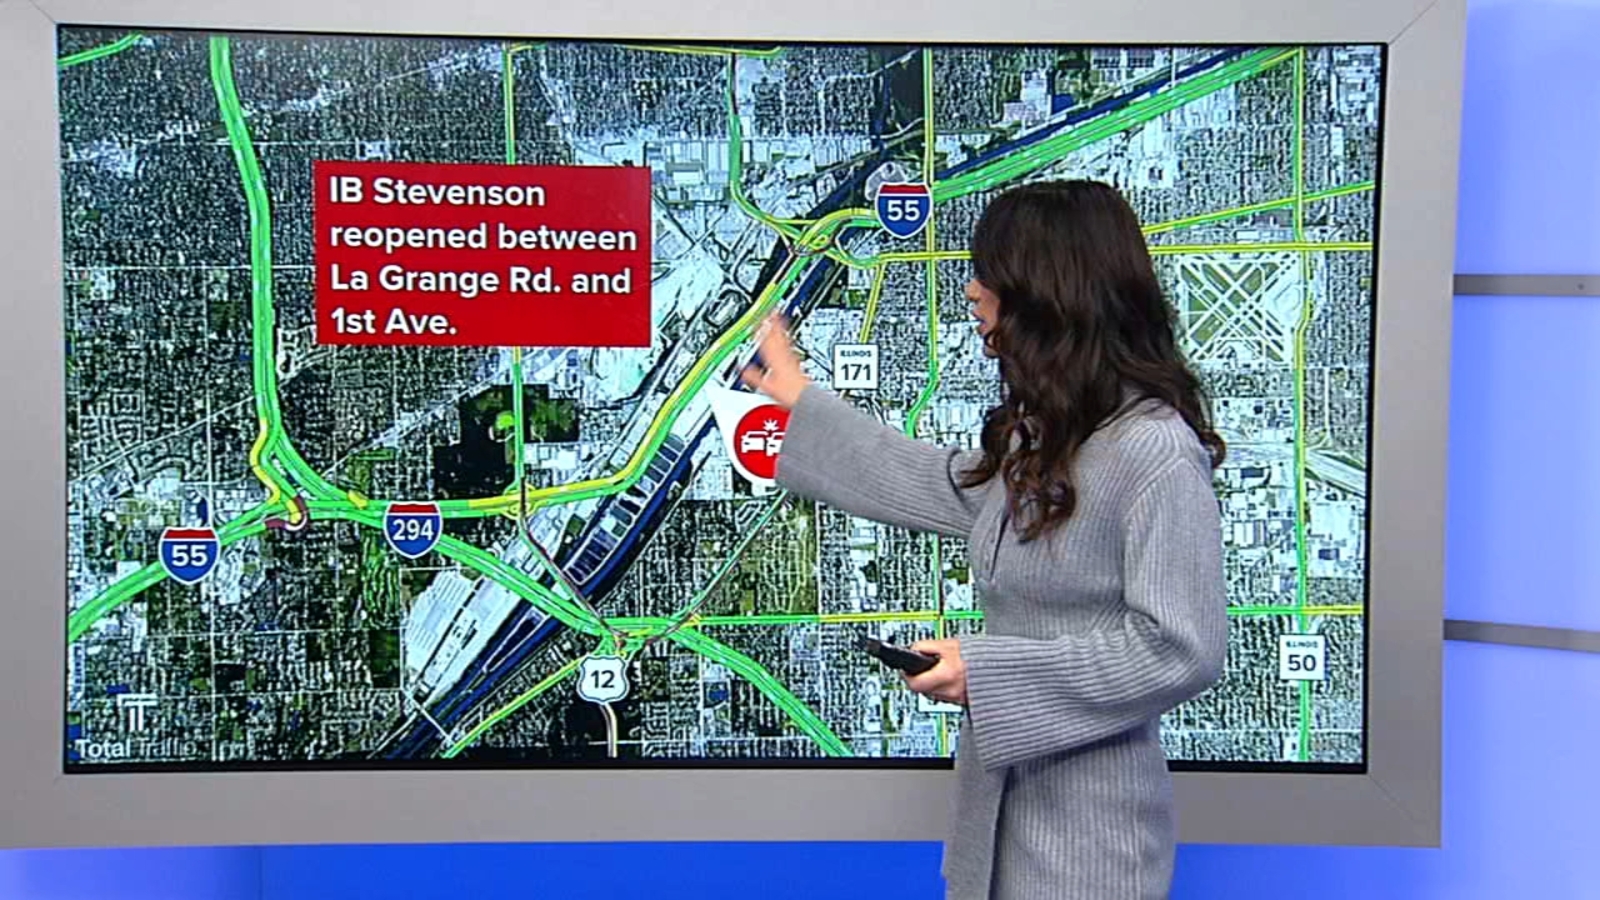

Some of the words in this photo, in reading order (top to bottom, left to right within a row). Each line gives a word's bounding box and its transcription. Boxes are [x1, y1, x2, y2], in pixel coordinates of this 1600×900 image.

[329, 176, 363, 204] IB
[373, 177, 546, 206] Stevenson
[887, 200, 921, 222] 55
[330, 222, 487, 254] reopened
[498, 223, 637, 251] between
[330, 263, 369, 291] La
[379, 264, 500, 298] Grange
[509, 266, 561, 293] Rd.
[571, 267, 631, 294] and
[330, 307, 376, 334] 1st
[384, 307, 457, 335] Ave.
[840, 363, 872, 381] 171
[392, 519, 434, 541] 294
[171, 544, 208, 567] 55
[1288, 654, 1317, 672] 50
[590, 669, 615, 689] 12
[75, 738, 131, 759] Total
